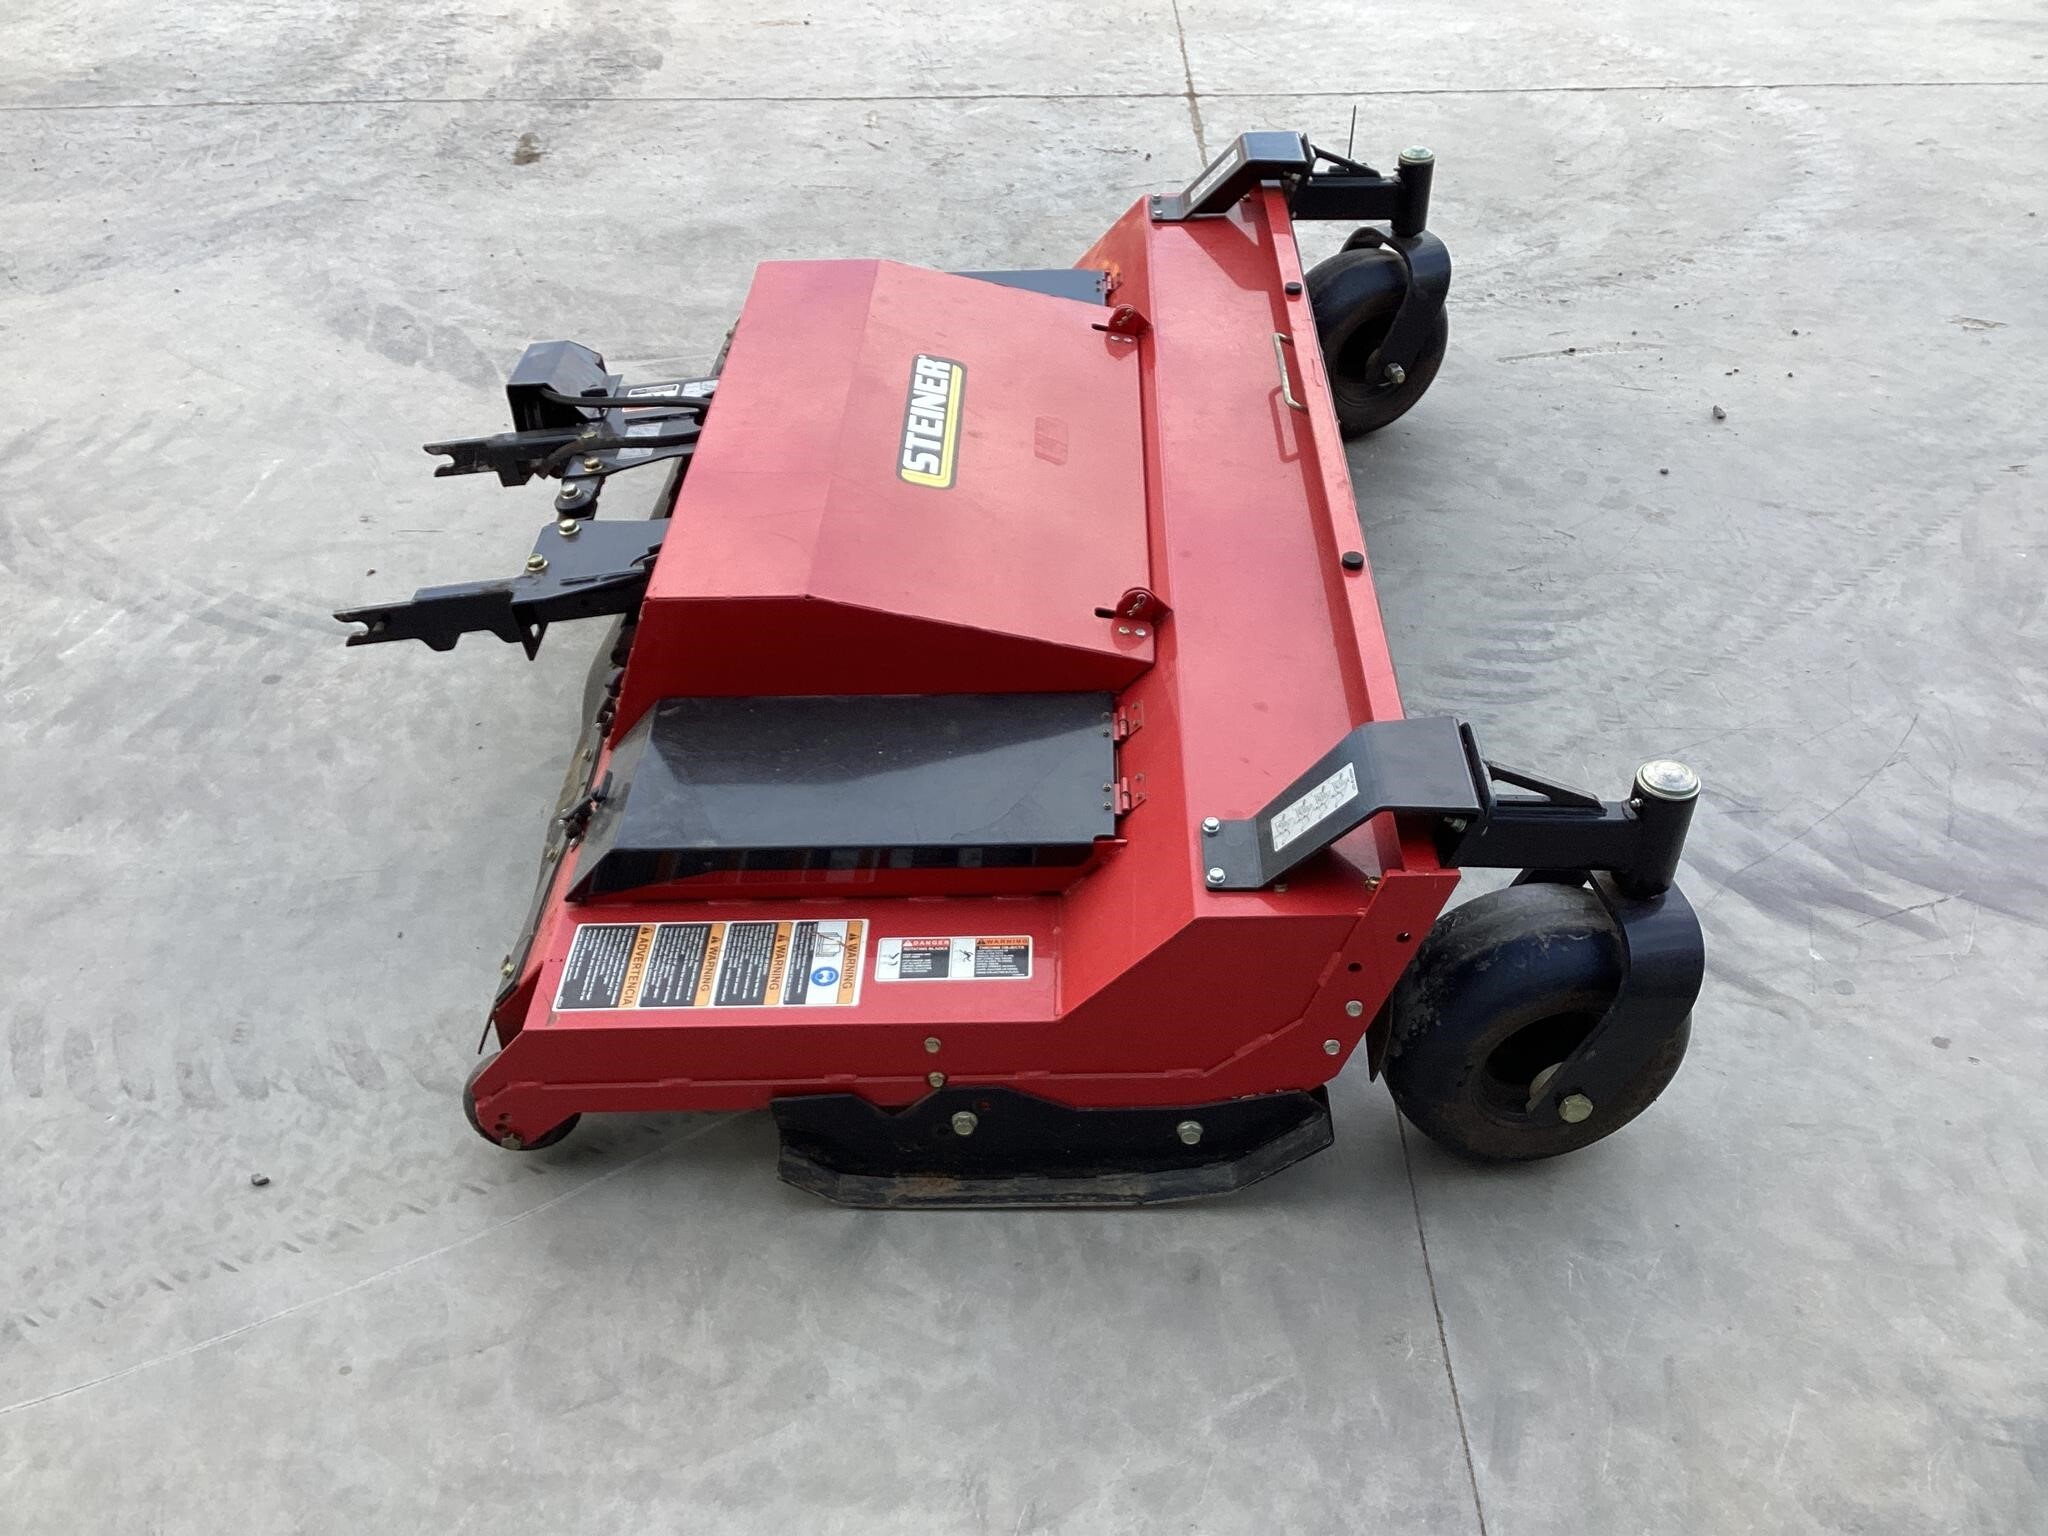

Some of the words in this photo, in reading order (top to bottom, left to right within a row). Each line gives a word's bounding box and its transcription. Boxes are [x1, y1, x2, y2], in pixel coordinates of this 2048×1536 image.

[902, 357, 951, 475] STEINER
[623, 937, 648, 1006] ADVERTENCIA
[701, 949, 720, 992] WARNING
[768, 943, 787, 990] WARNING
[842, 942, 859, 989] WARNING
